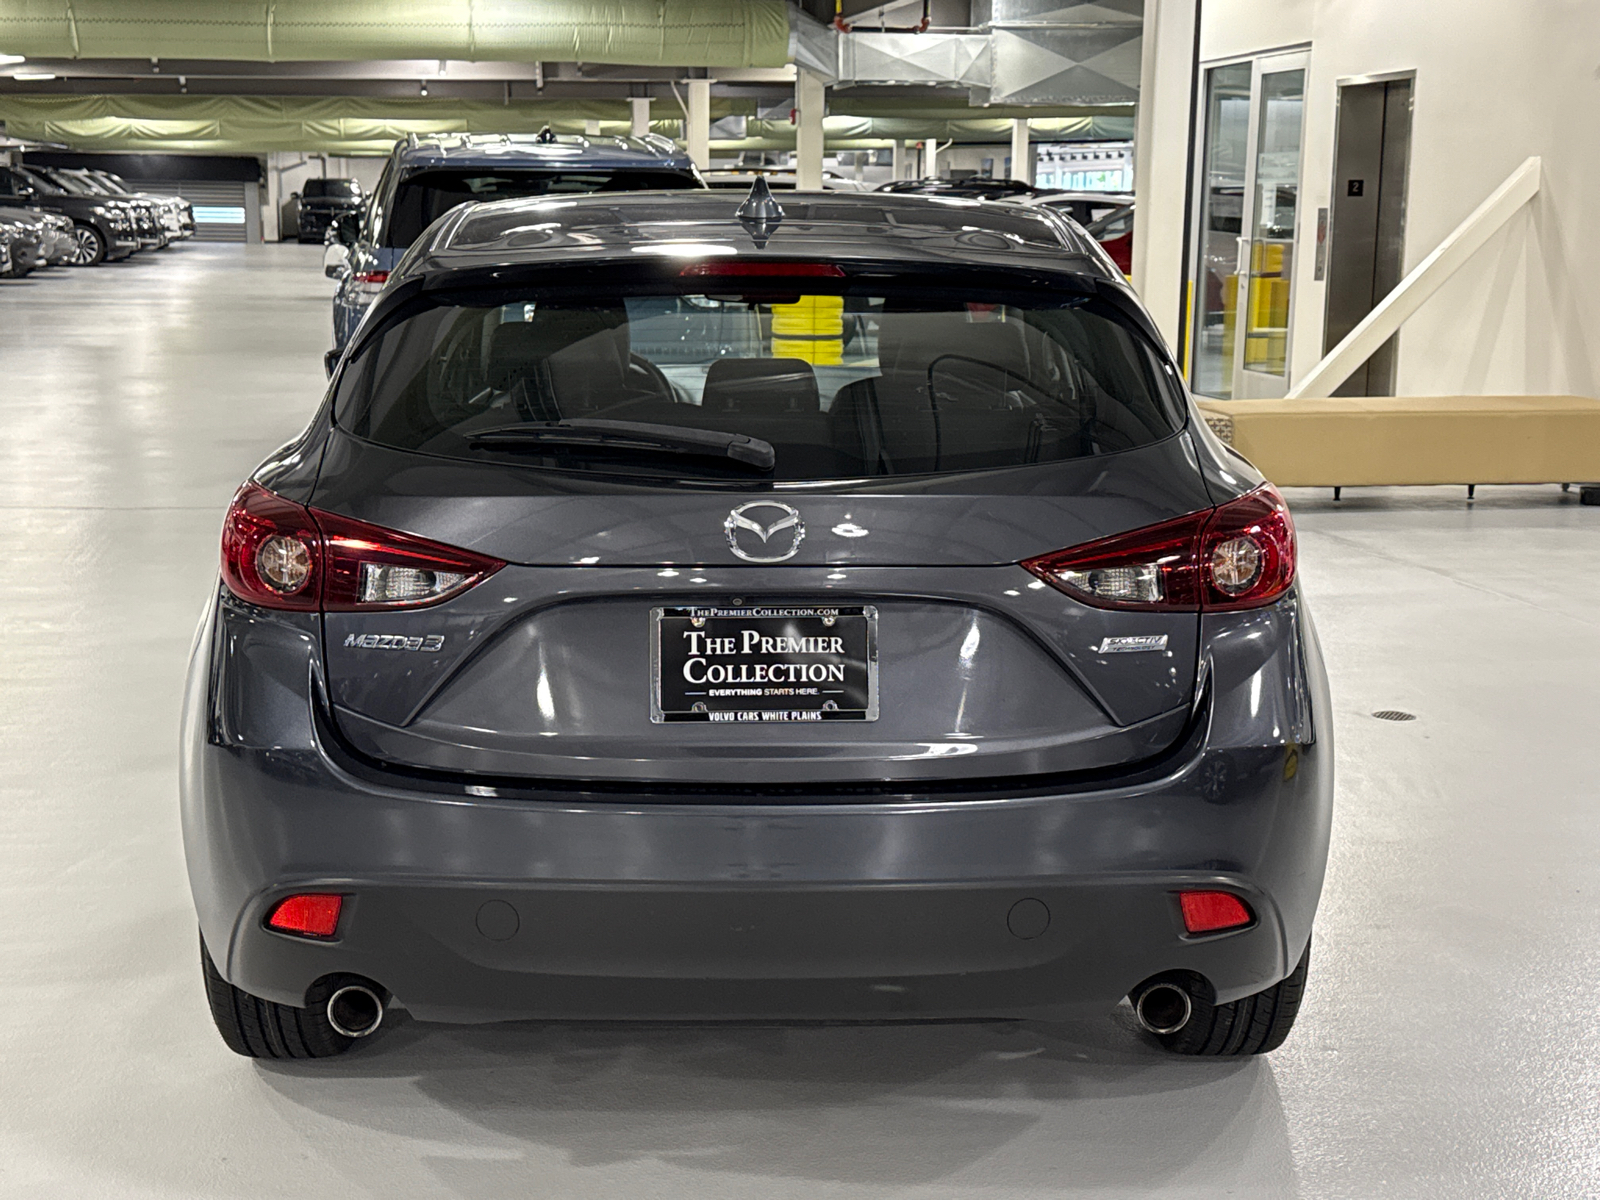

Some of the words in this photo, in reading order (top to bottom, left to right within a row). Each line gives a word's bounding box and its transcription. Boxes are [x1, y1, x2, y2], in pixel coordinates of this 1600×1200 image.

[1352, 181, 1359, 192] 2
[683, 631, 736, 655] THE
[741, 630, 845, 654] PREMIER
[683, 657, 845, 684] COLLECTION
[709, 688, 762, 696] EVERYTHING
[764, 687, 794, 696] STARTS
[708, 712, 734, 721] VOLVO
[737, 711, 759, 721] CARS
[761, 711, 789, 721] WHITE
[791, 711, 822, 721] PLAINS
